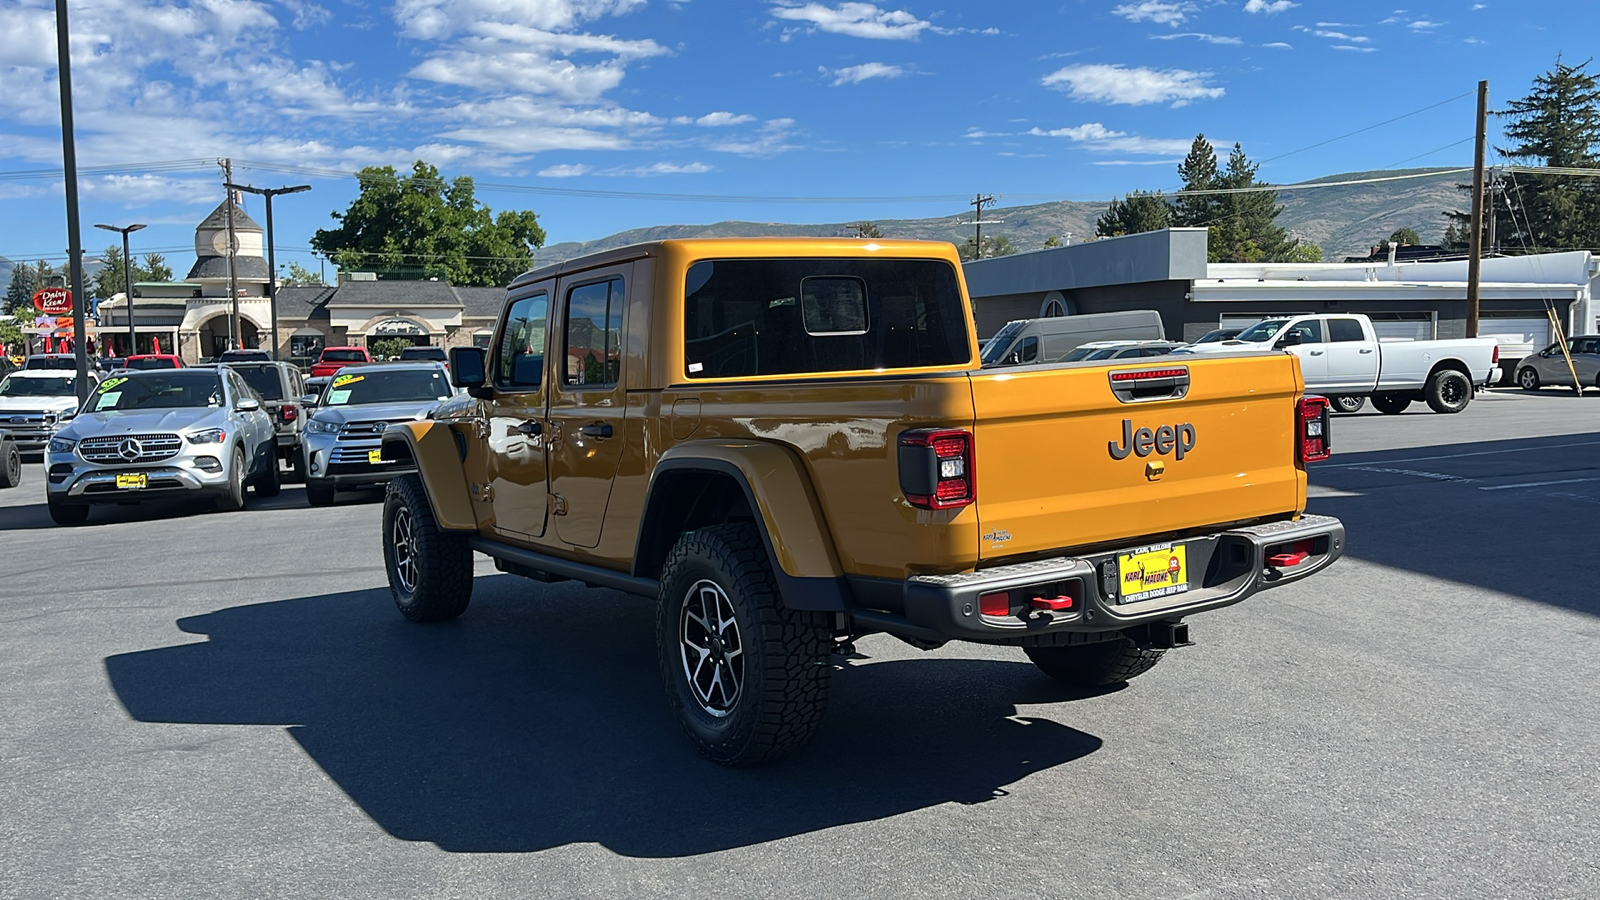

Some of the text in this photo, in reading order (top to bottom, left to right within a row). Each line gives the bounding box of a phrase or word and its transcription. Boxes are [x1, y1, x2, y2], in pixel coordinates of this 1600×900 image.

[40, 290, 67, 304] Dairy
[1108, 419, 1196, 461] Jeep
[1124, 571, 1169, 585] KARL MALONE
[1125, 584, 1188, 602] CHRYSLER DODGE JEEP RAM
